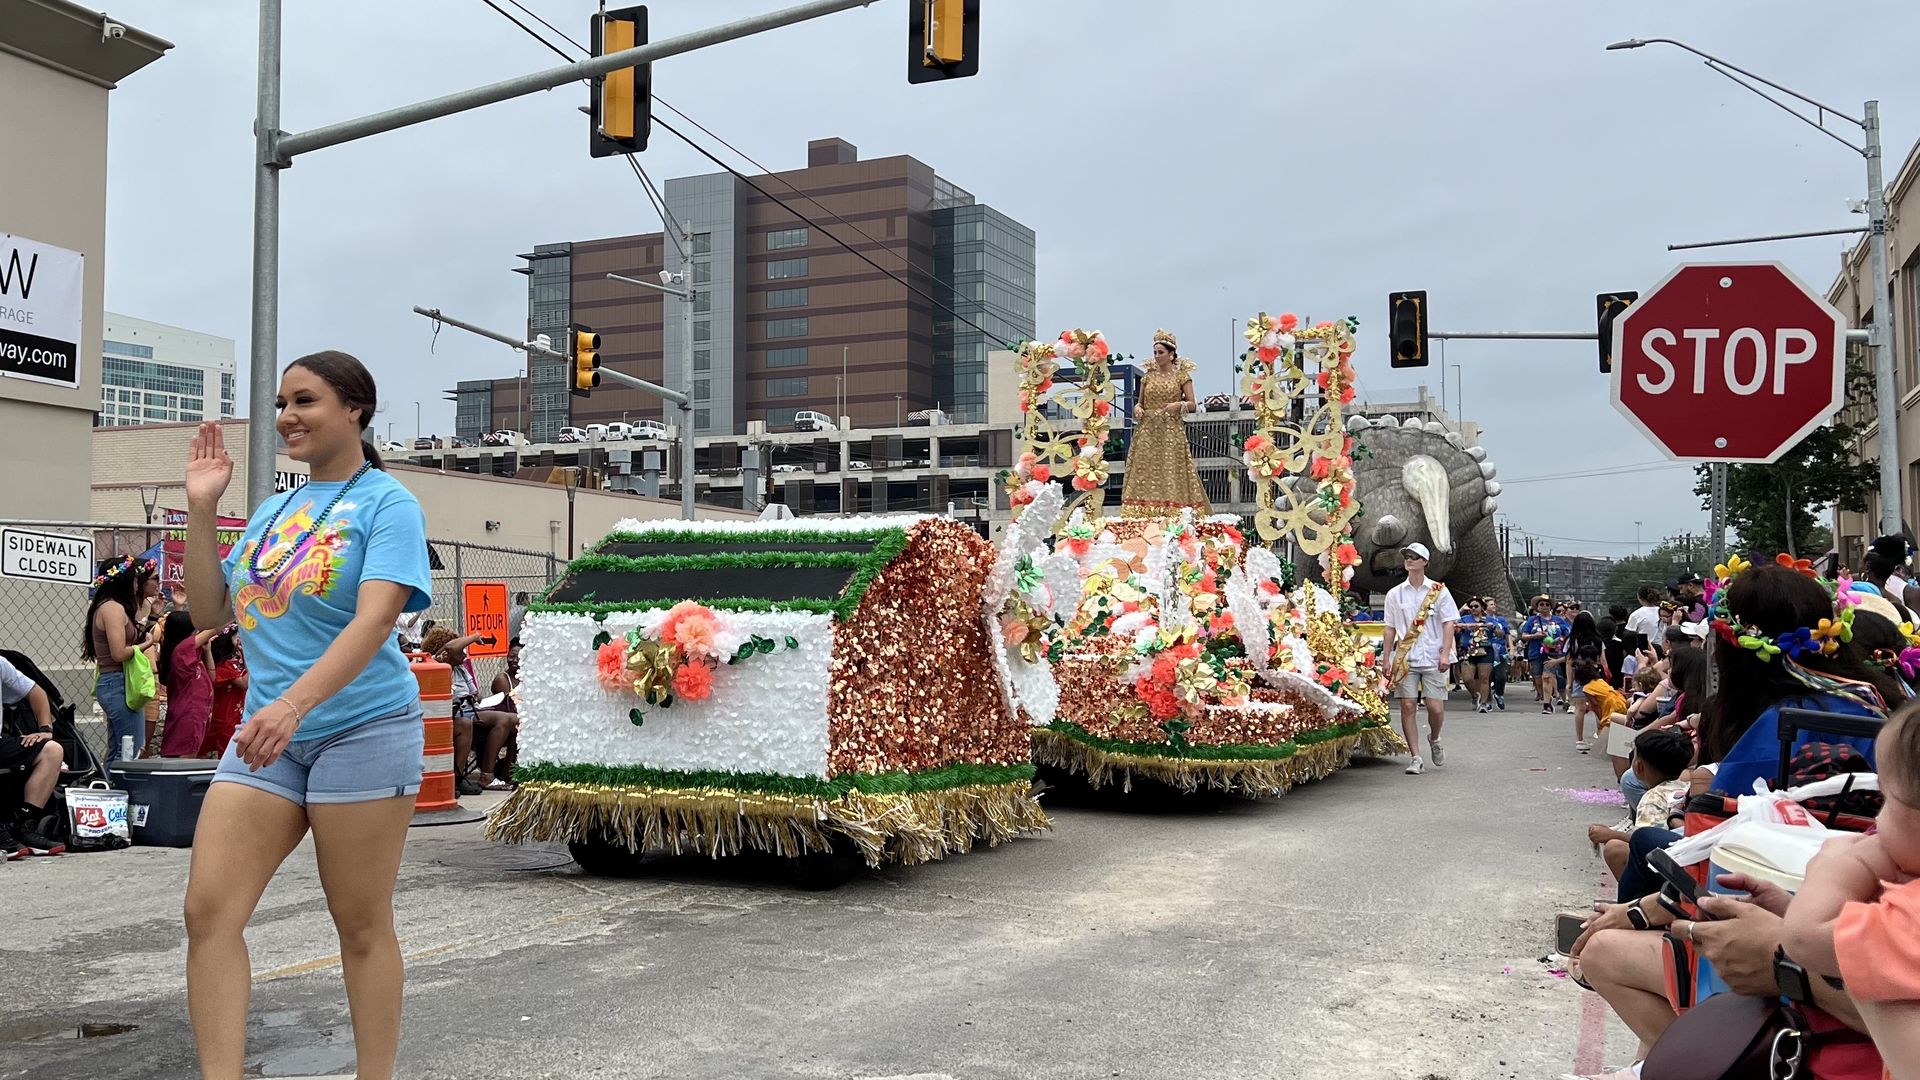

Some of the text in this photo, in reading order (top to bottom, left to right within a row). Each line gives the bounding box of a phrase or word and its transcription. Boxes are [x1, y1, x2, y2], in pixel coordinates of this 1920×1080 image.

[1636, 327, 1818, 396] STOP
[9, 536, 87, 559] SIDEWALK
[19, 557, 77, 576] CLOSED
[470, 613, 504, 631] DETOUR
[81, 809, 101, 823] Hot
